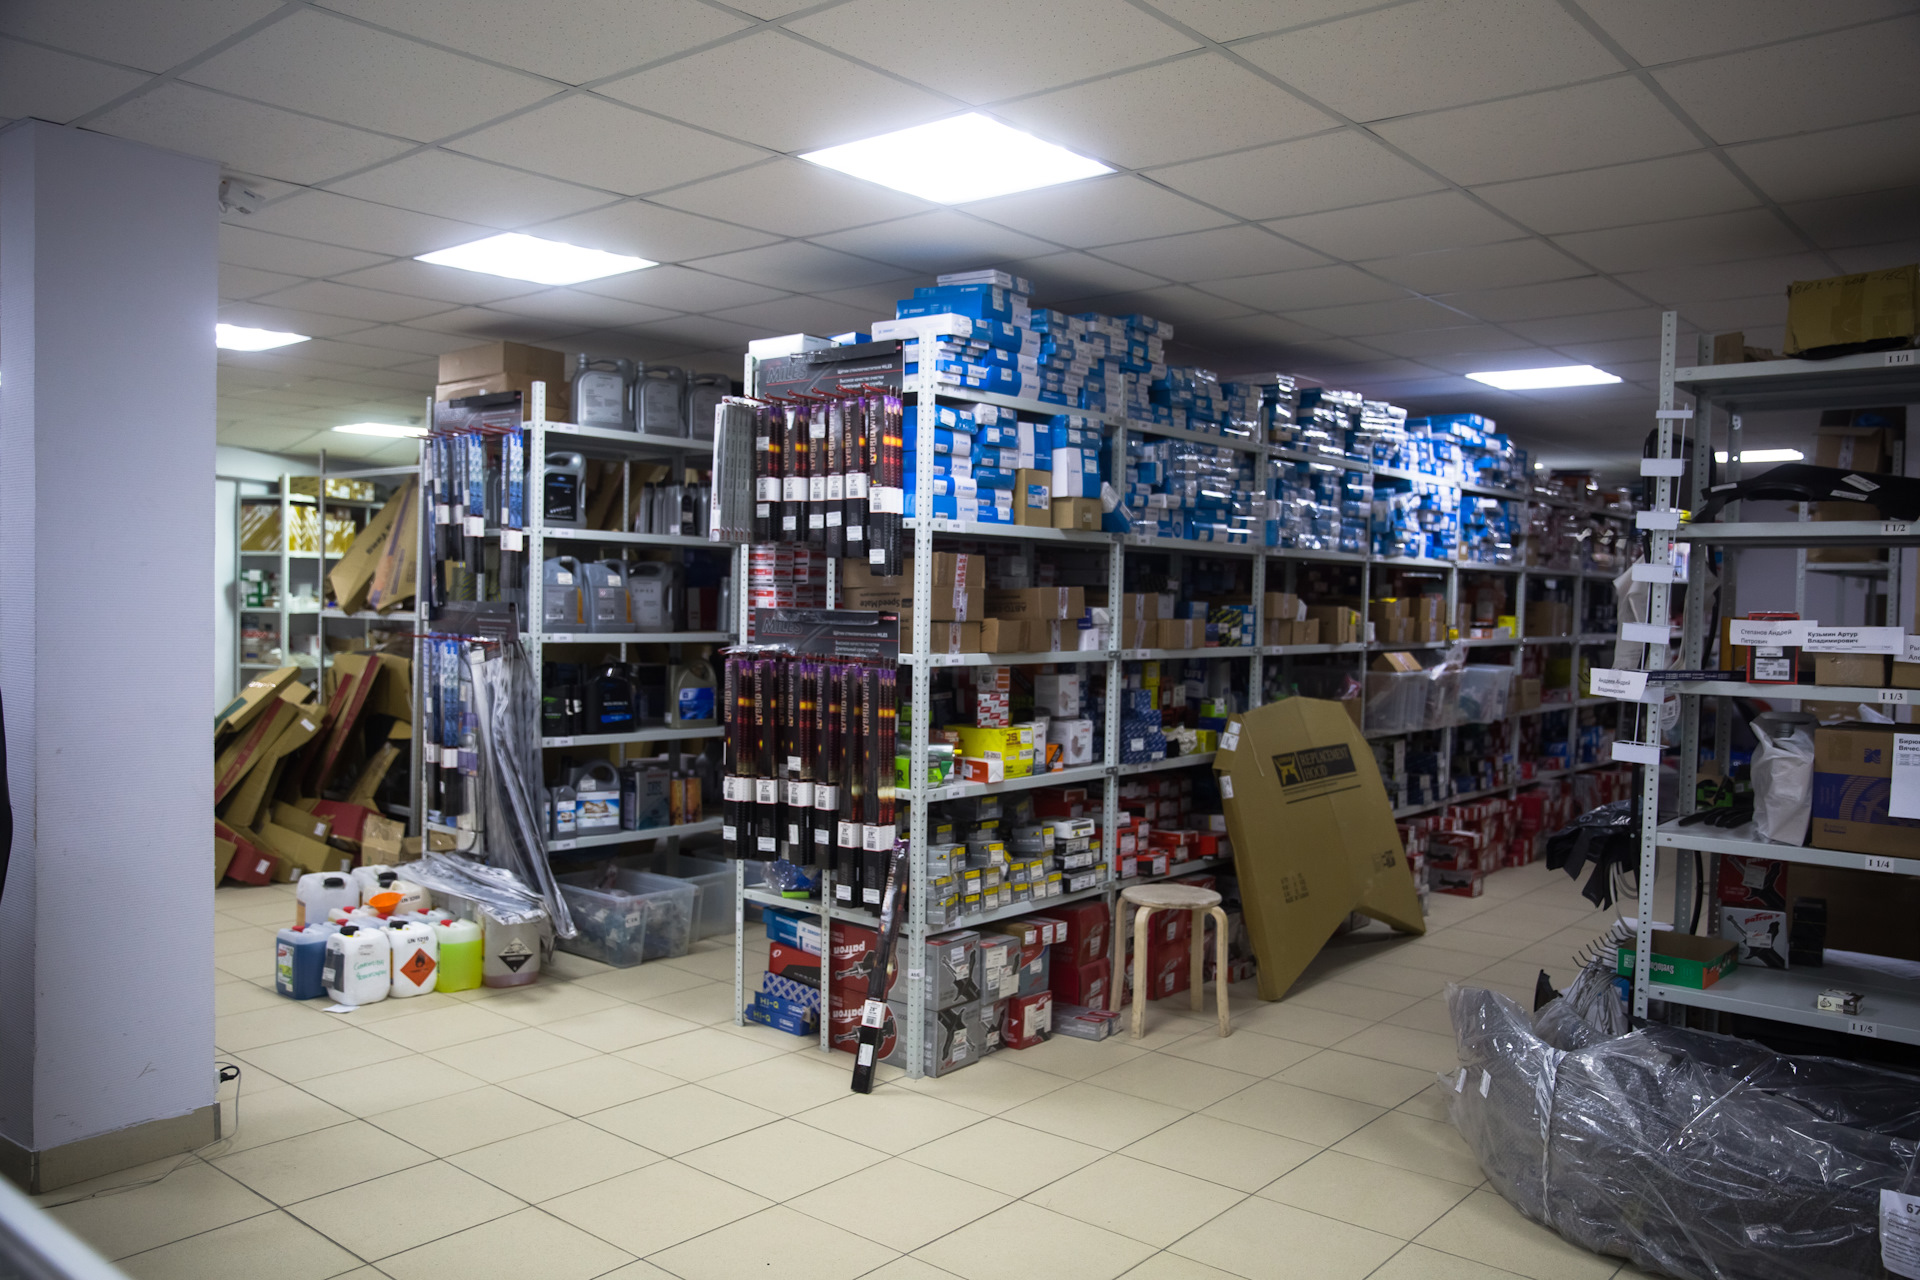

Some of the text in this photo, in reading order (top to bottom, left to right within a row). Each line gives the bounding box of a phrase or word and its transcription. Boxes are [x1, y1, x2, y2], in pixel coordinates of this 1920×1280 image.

[1896, 354, 1909, 363] 1/1
[1893, 524, 1906, 532] 1/2
[1740, 628, 1792, 636] Степанов Андрей
[1837, 631, 1858, 639] Артур
[1889, 692, 1903, 700] 1/3
[1300, 746, 1349, 767] REPLACEMENT
[1304, 764, 1328, 780] HOOD
[1876, 860, 1890, 868] 1/4
[833, 940, 866, 954] patron
[833, 1005, 865, 1018] patron
[1859, 1024, 1873, 1033] 1/5
